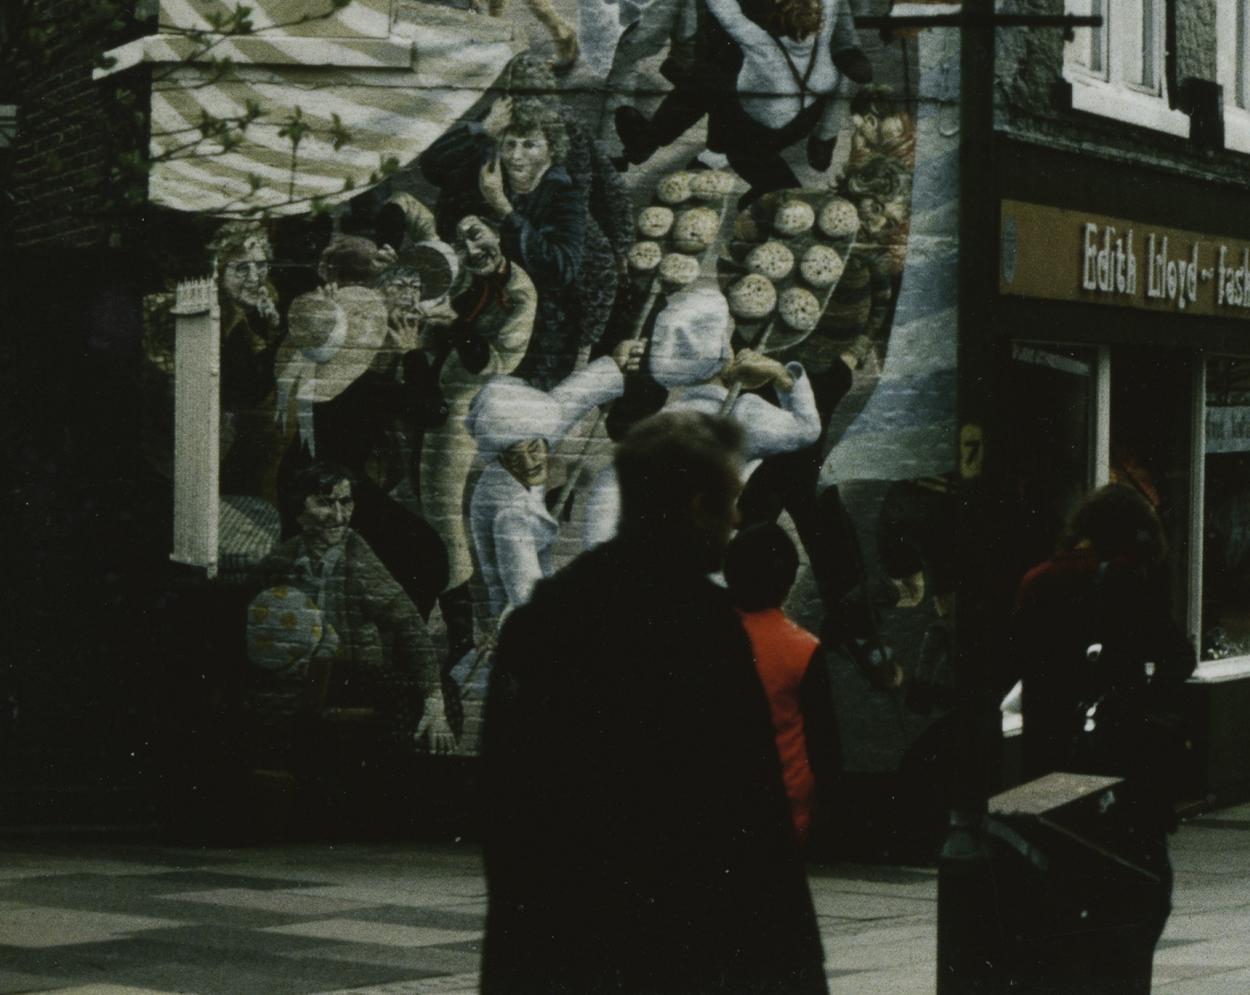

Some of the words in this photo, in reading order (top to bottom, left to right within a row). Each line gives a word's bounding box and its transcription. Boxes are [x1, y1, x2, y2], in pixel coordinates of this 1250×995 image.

[1082, 221, 1137, 295] Edith
[1147, 233, 1199, 310] Lloyd
[965, 440, 980, 465] 7
